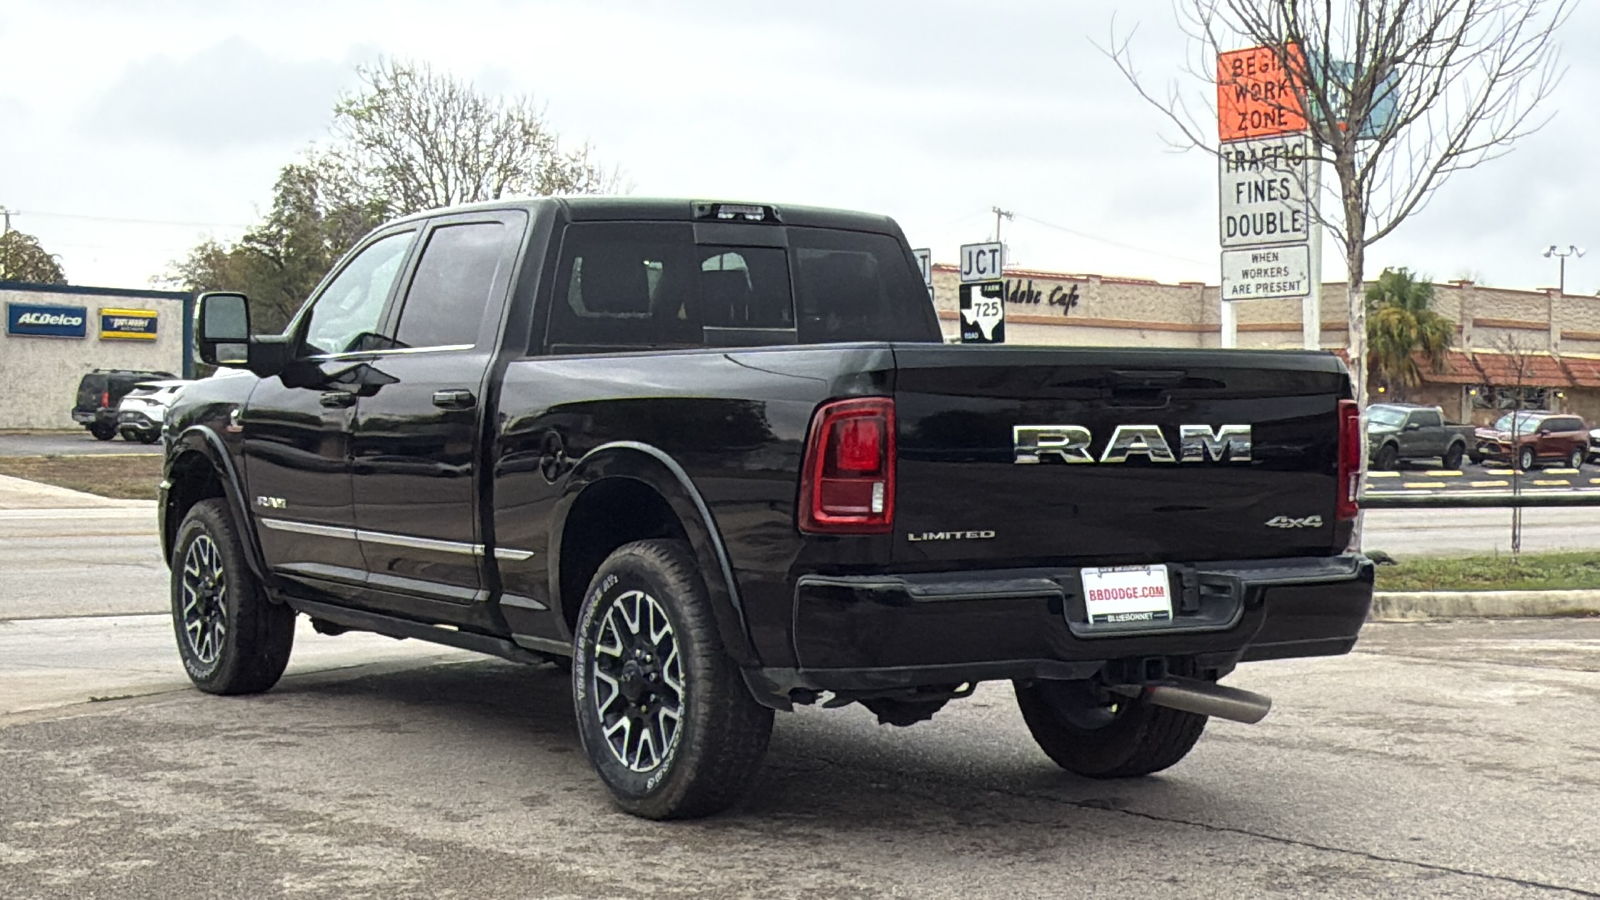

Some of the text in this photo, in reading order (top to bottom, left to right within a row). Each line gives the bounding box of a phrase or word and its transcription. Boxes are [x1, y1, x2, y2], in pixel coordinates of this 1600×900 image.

[1235, 79, 1288, 103] WORK
[1238, 107, 1287, 131] ZONE
[1223, 143, 1303, 174] TRAFFIC
[1236, 178, 1290, 204] FINES
[1226, 210, 1302, 238] DOUBLE
[963, 248, 999, 276] JCT
[1251, 252, 1279, 263] WHEN
[1241, 267, 1289, 279] WORKERS
[1231, 281, 1301, 294] ARE PRESENT
[974, 302, 999, 317] 725
[17, 312, 83, 326] ACDelco
[1012, 424, 1252, 464] RAM
[256, 496, 287, 509] RAM
[1264, 514, 1323, 529] 4x4
[908, 529, 996, 542] LIMITED
[1088, 585, 1165, 602] BBDODGE.COM
[1107, 612, 1154, 623] BLUEBONNET
